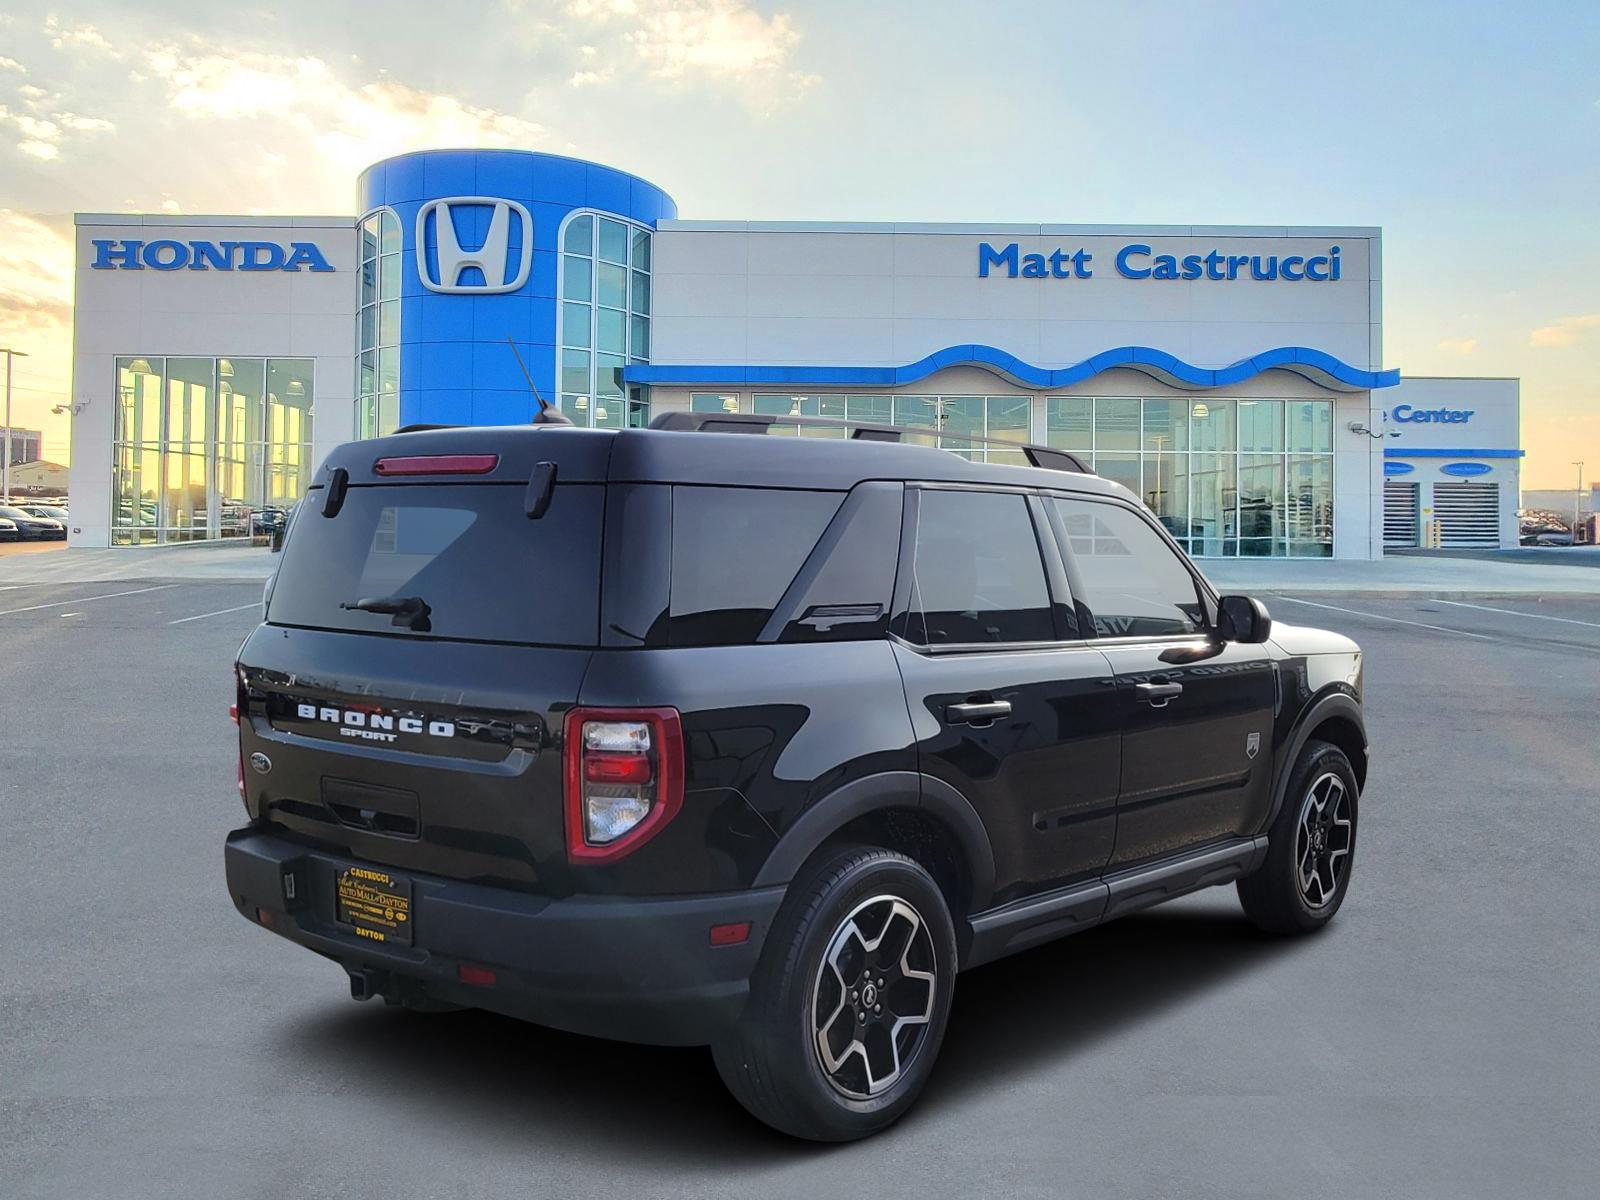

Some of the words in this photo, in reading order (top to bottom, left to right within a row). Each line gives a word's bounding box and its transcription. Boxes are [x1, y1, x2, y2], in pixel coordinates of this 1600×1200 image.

[91, 239, 336, 272] HONDA
[979, 242, 1093, 279] Matt
[1115, 243, 1342, 281] Castrucci
[1392, 404, 1475, 424] Center
[298, 703, 455, 738] BRONCO
[340, 727, 398, 742] SPORT
[350, 867, 389, 884] CASTRUCCI
[380, 895, 408, 909] DAYTON
[356, 927, 385, 941] DAYTON
